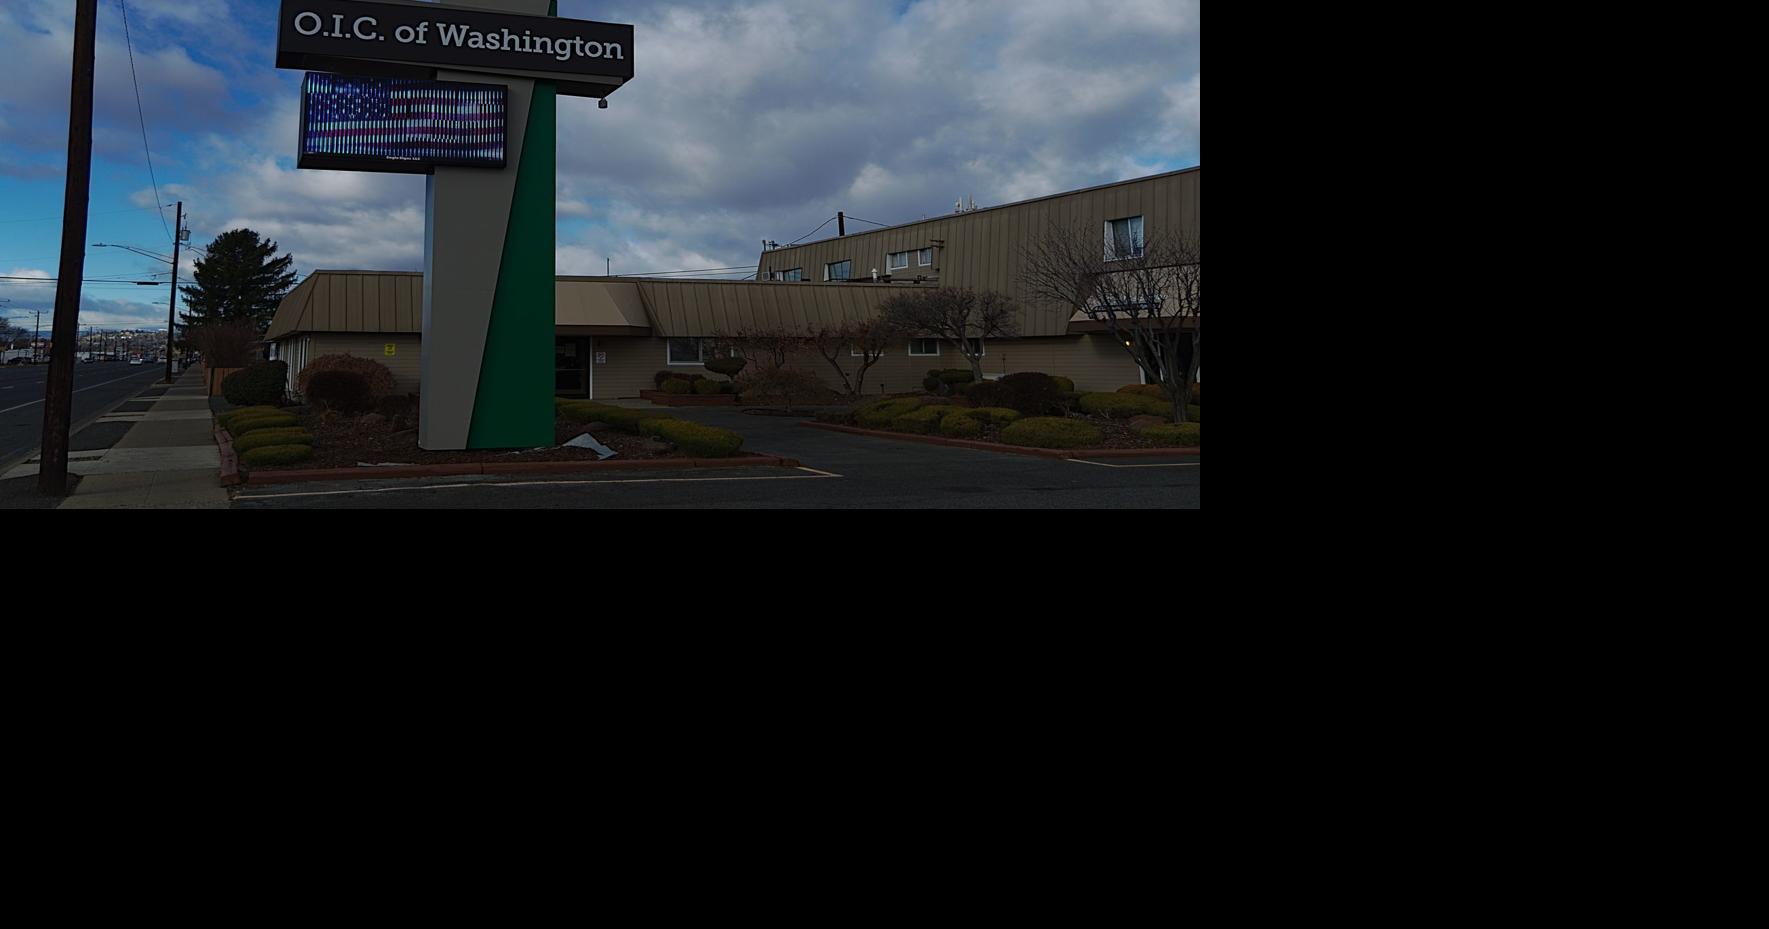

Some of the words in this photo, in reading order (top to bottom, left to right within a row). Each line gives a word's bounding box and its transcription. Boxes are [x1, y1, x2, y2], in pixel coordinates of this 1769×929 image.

[293, 11, 384, 41] O.I.C.
[394, 22, 428, 45] of
[435, 23, 624, 61] Washington
